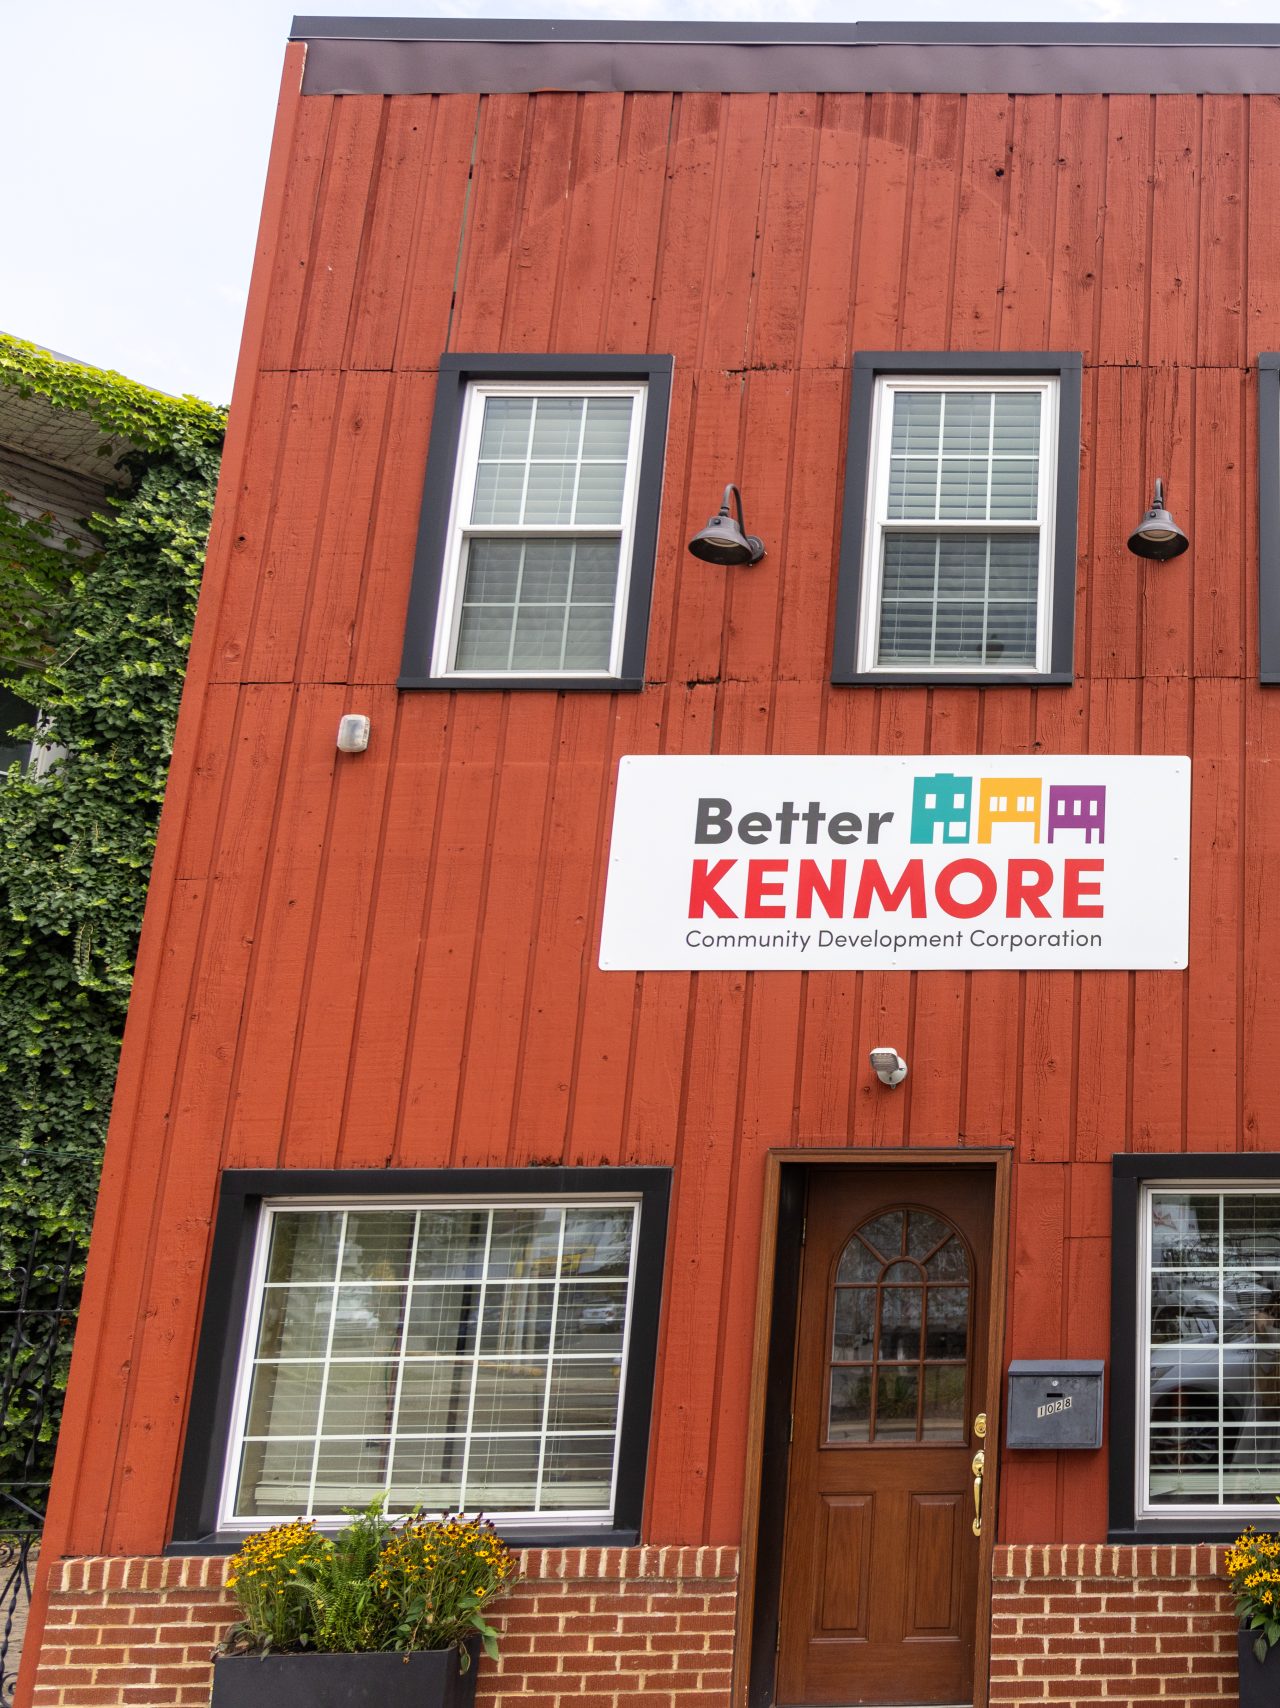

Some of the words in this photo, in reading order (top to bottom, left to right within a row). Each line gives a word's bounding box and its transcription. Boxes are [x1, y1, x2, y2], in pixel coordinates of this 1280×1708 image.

[695, 798, 894, 845] Better
[688, 858, 1104, 919] KENMORE
[686, 930, 811, 952] Community
[818, 930, 963, 952] Development
[970, 930, 1102, 952] Corporation
[1039, 1398, 1072, 1415] 1028
